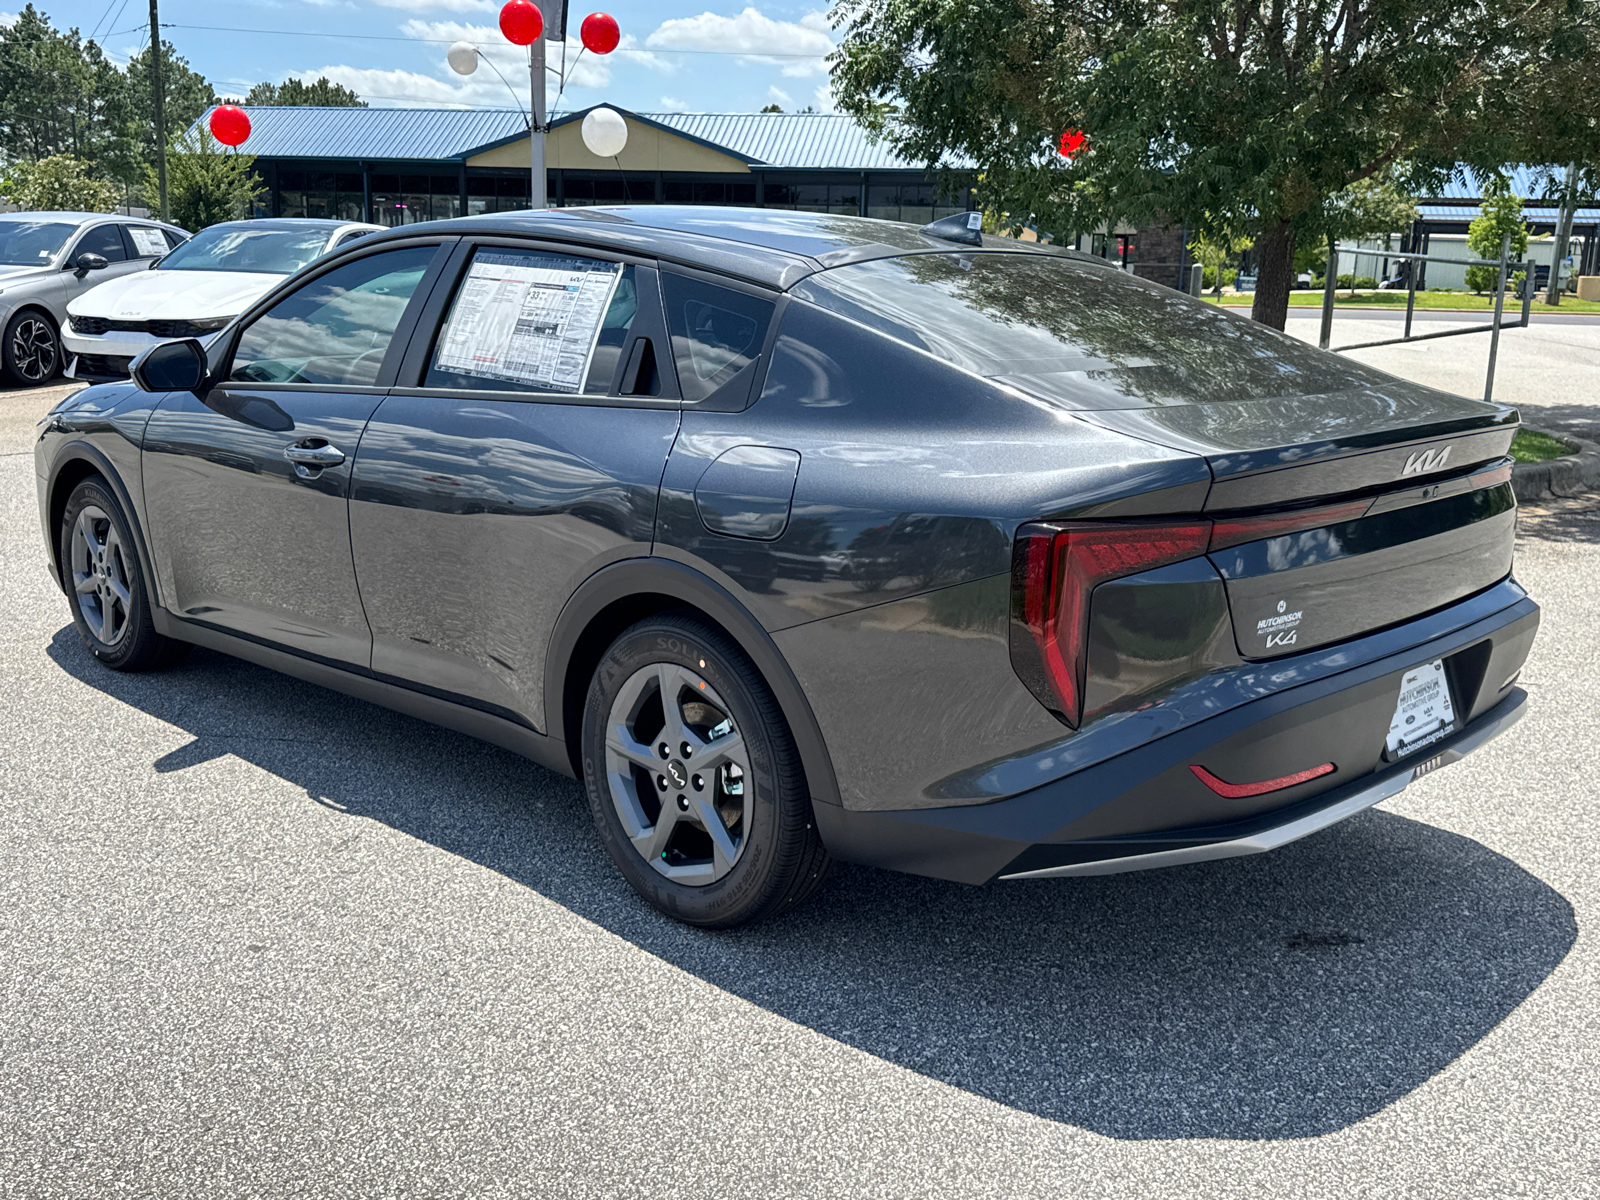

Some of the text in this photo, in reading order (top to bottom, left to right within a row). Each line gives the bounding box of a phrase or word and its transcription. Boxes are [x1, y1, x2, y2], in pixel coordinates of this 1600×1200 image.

[1401, 445, 1452, 476] KIA
[84, 487, 110, 511] KUMHO
[1257, 611, 1303, 629] HUTCHINSON
[1257, 624, 1285, 634] AUTOMOTIVE
[1266, 630, 1297, 648] K4
[656, 637, 717, 675] SOLUS
[1399, 679, 1441, 706] HUTCHINSON
[1402, 697, 1427, 714] AUTOMOTIVE
[1426, 690, 1440, 703] GROUP
[585, 757, 613, 843] KUMHO
